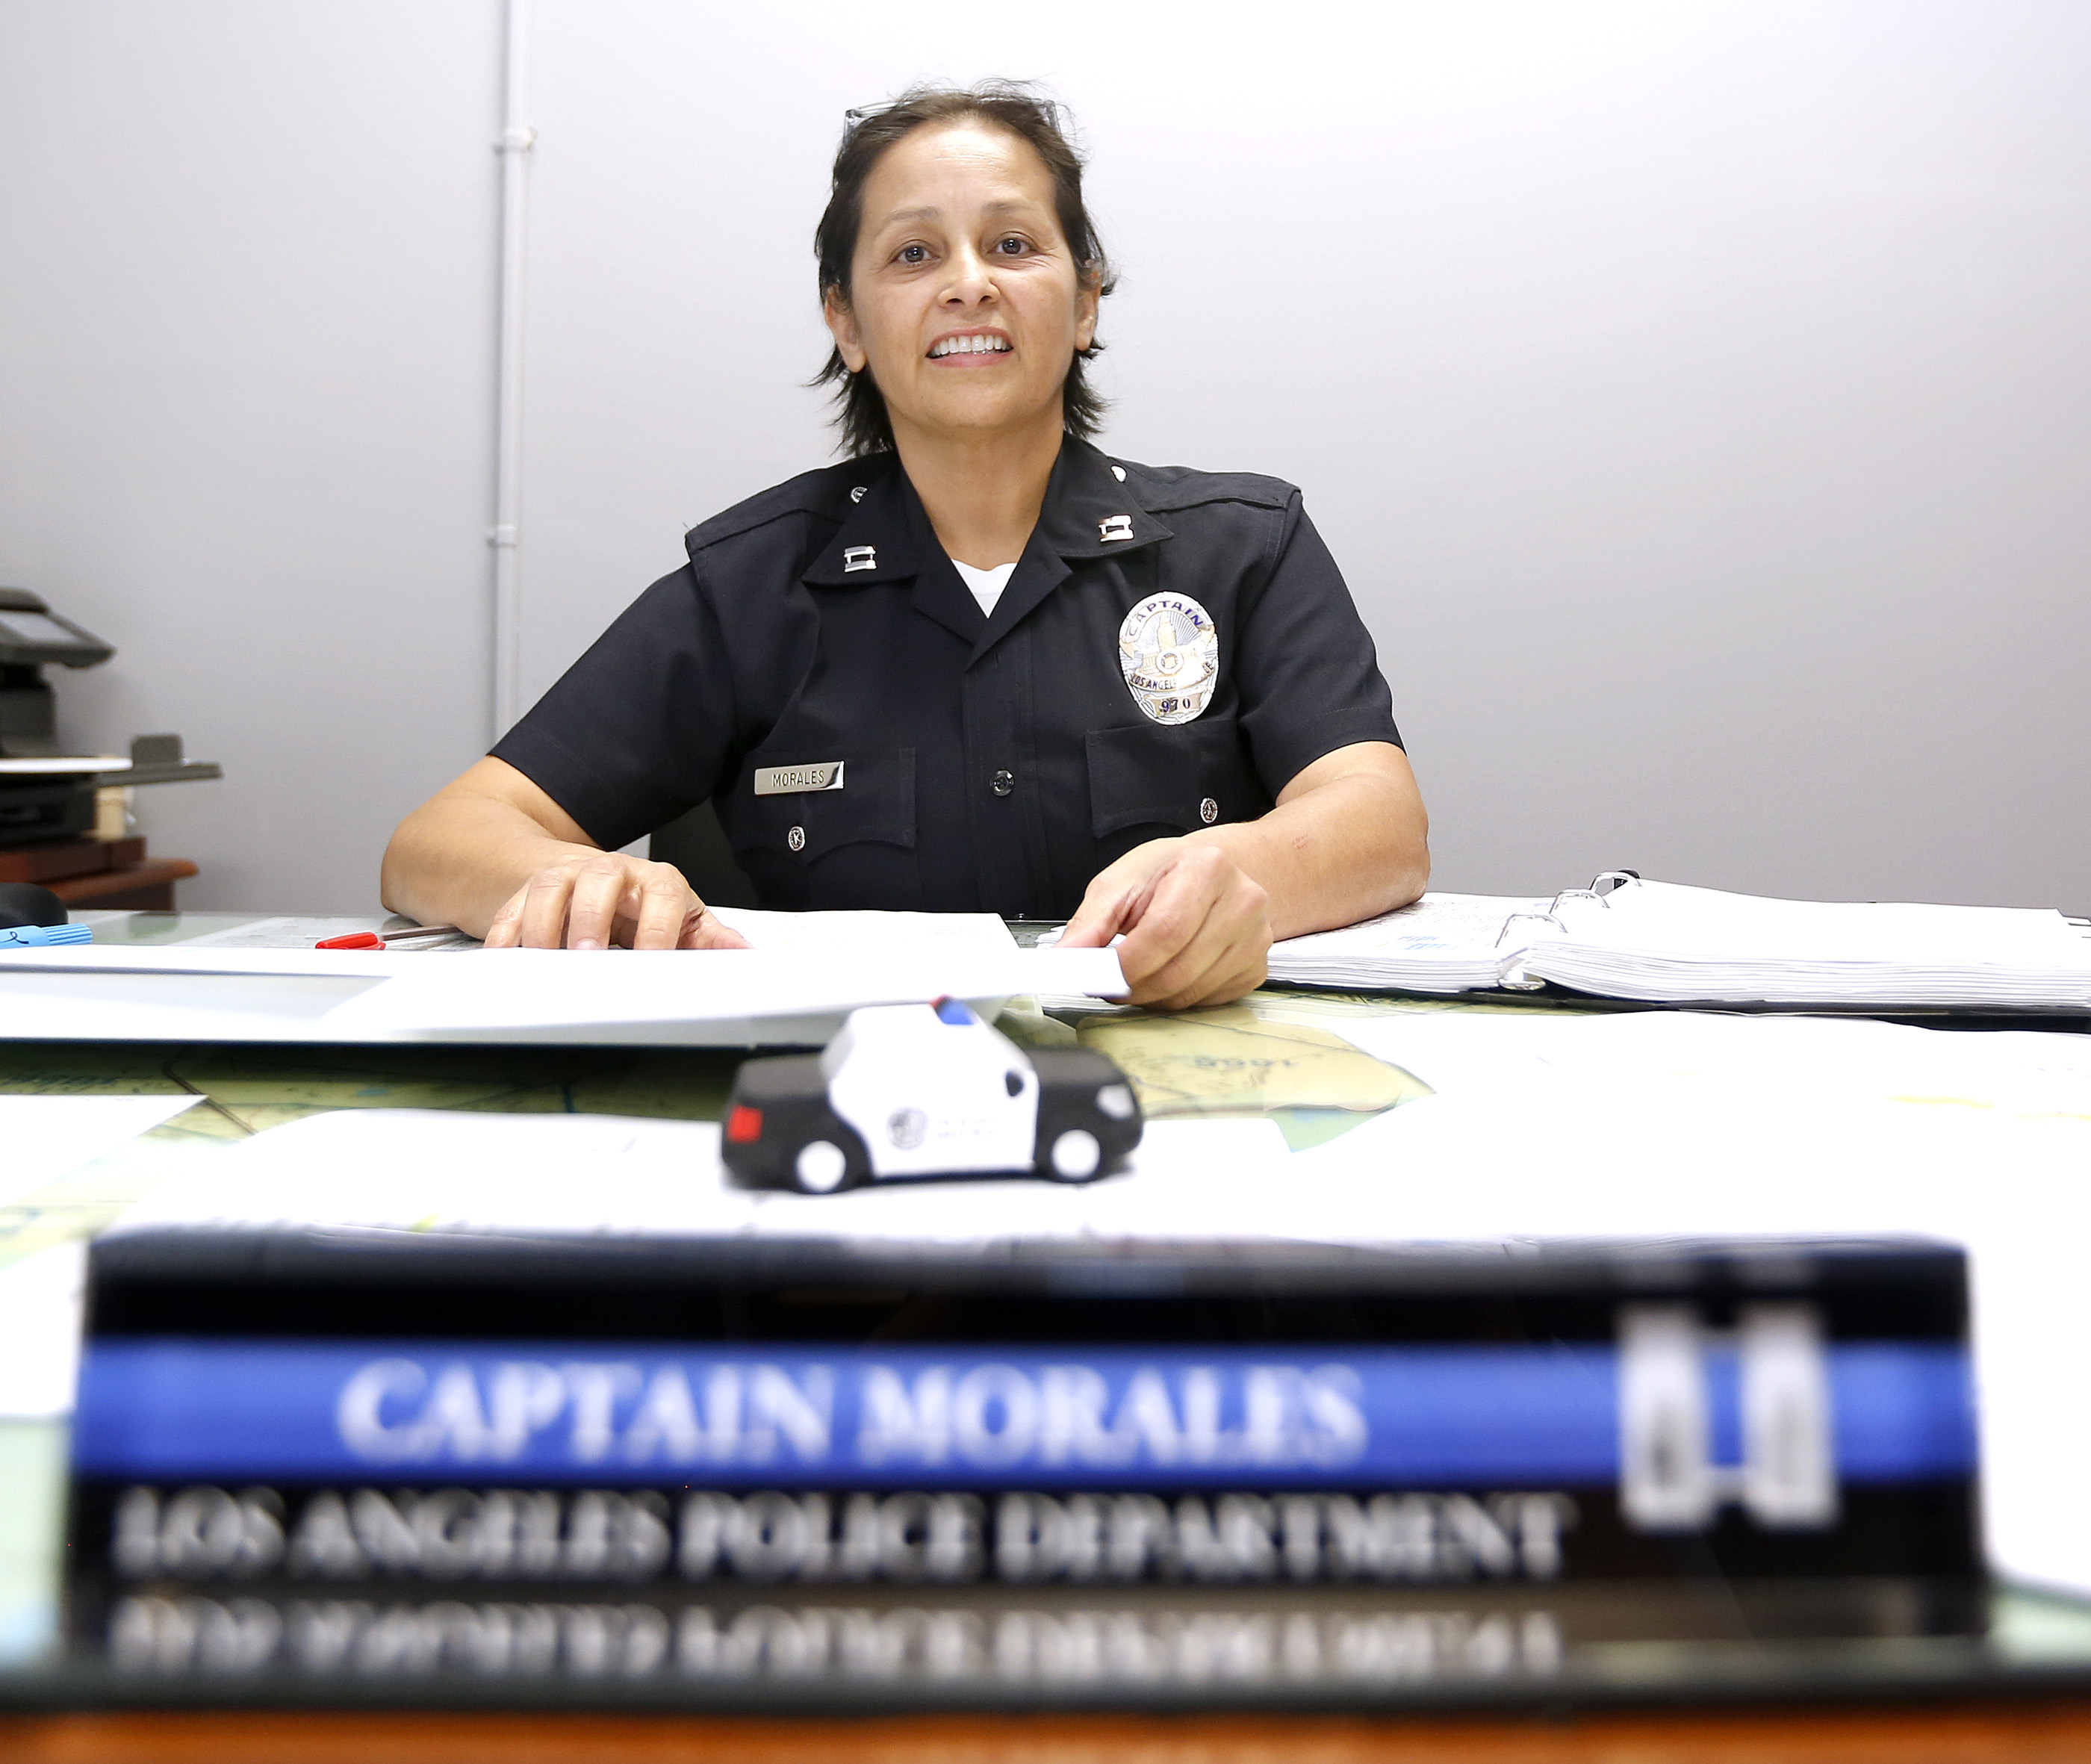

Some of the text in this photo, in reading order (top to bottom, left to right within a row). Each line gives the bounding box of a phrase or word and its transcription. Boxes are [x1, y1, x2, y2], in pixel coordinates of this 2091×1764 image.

[1129, 600, 1203, 636] CAPTAIN
[1131, 674, 1146, 686] LOS
[1160, 698, 1191, 712] 970
[771, 770, 824, 787] MORALES
[336, 1359, 1368, 1469] CAPTAIN MORALES
[112, 1485, 1579, 1580] LOS ANGELES POLICE DEPARTMENT
